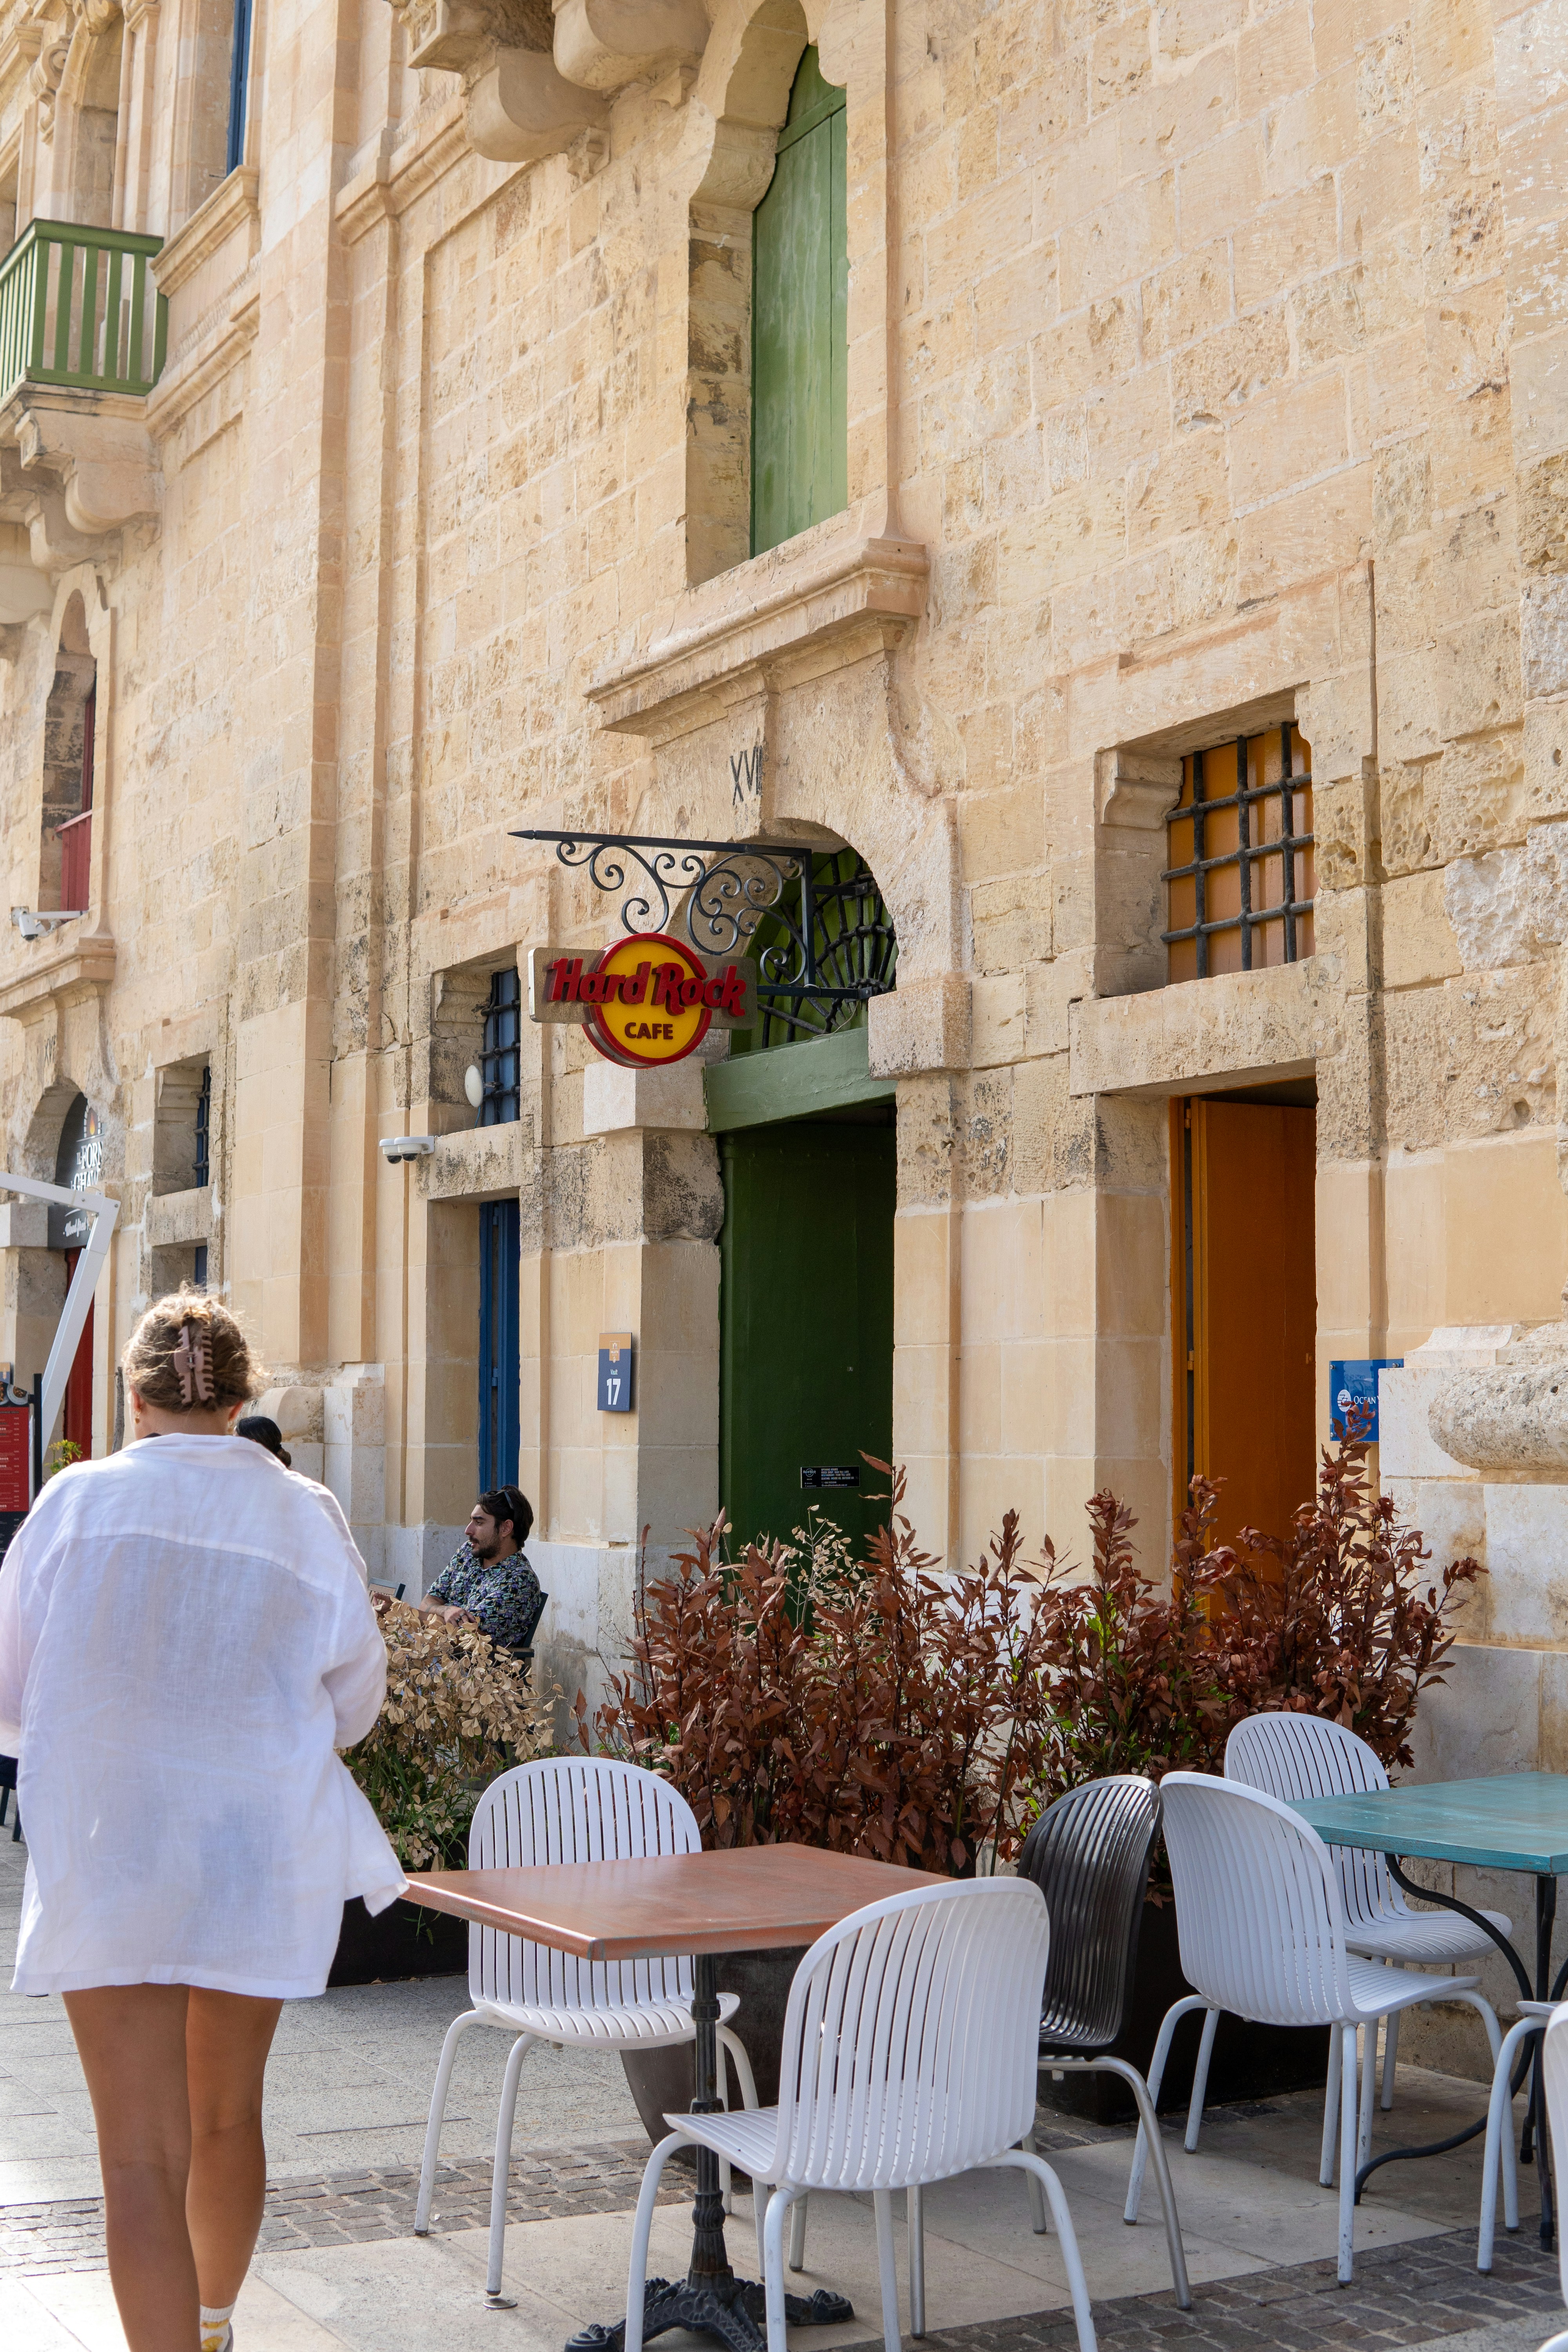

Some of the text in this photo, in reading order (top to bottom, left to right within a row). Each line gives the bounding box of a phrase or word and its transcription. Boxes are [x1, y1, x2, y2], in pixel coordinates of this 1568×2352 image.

[548, 957, 746, 1017] Hard Rock
[624, 1022, 673, 1040] CAFE
[606, 1378, 621, 1405] 17
